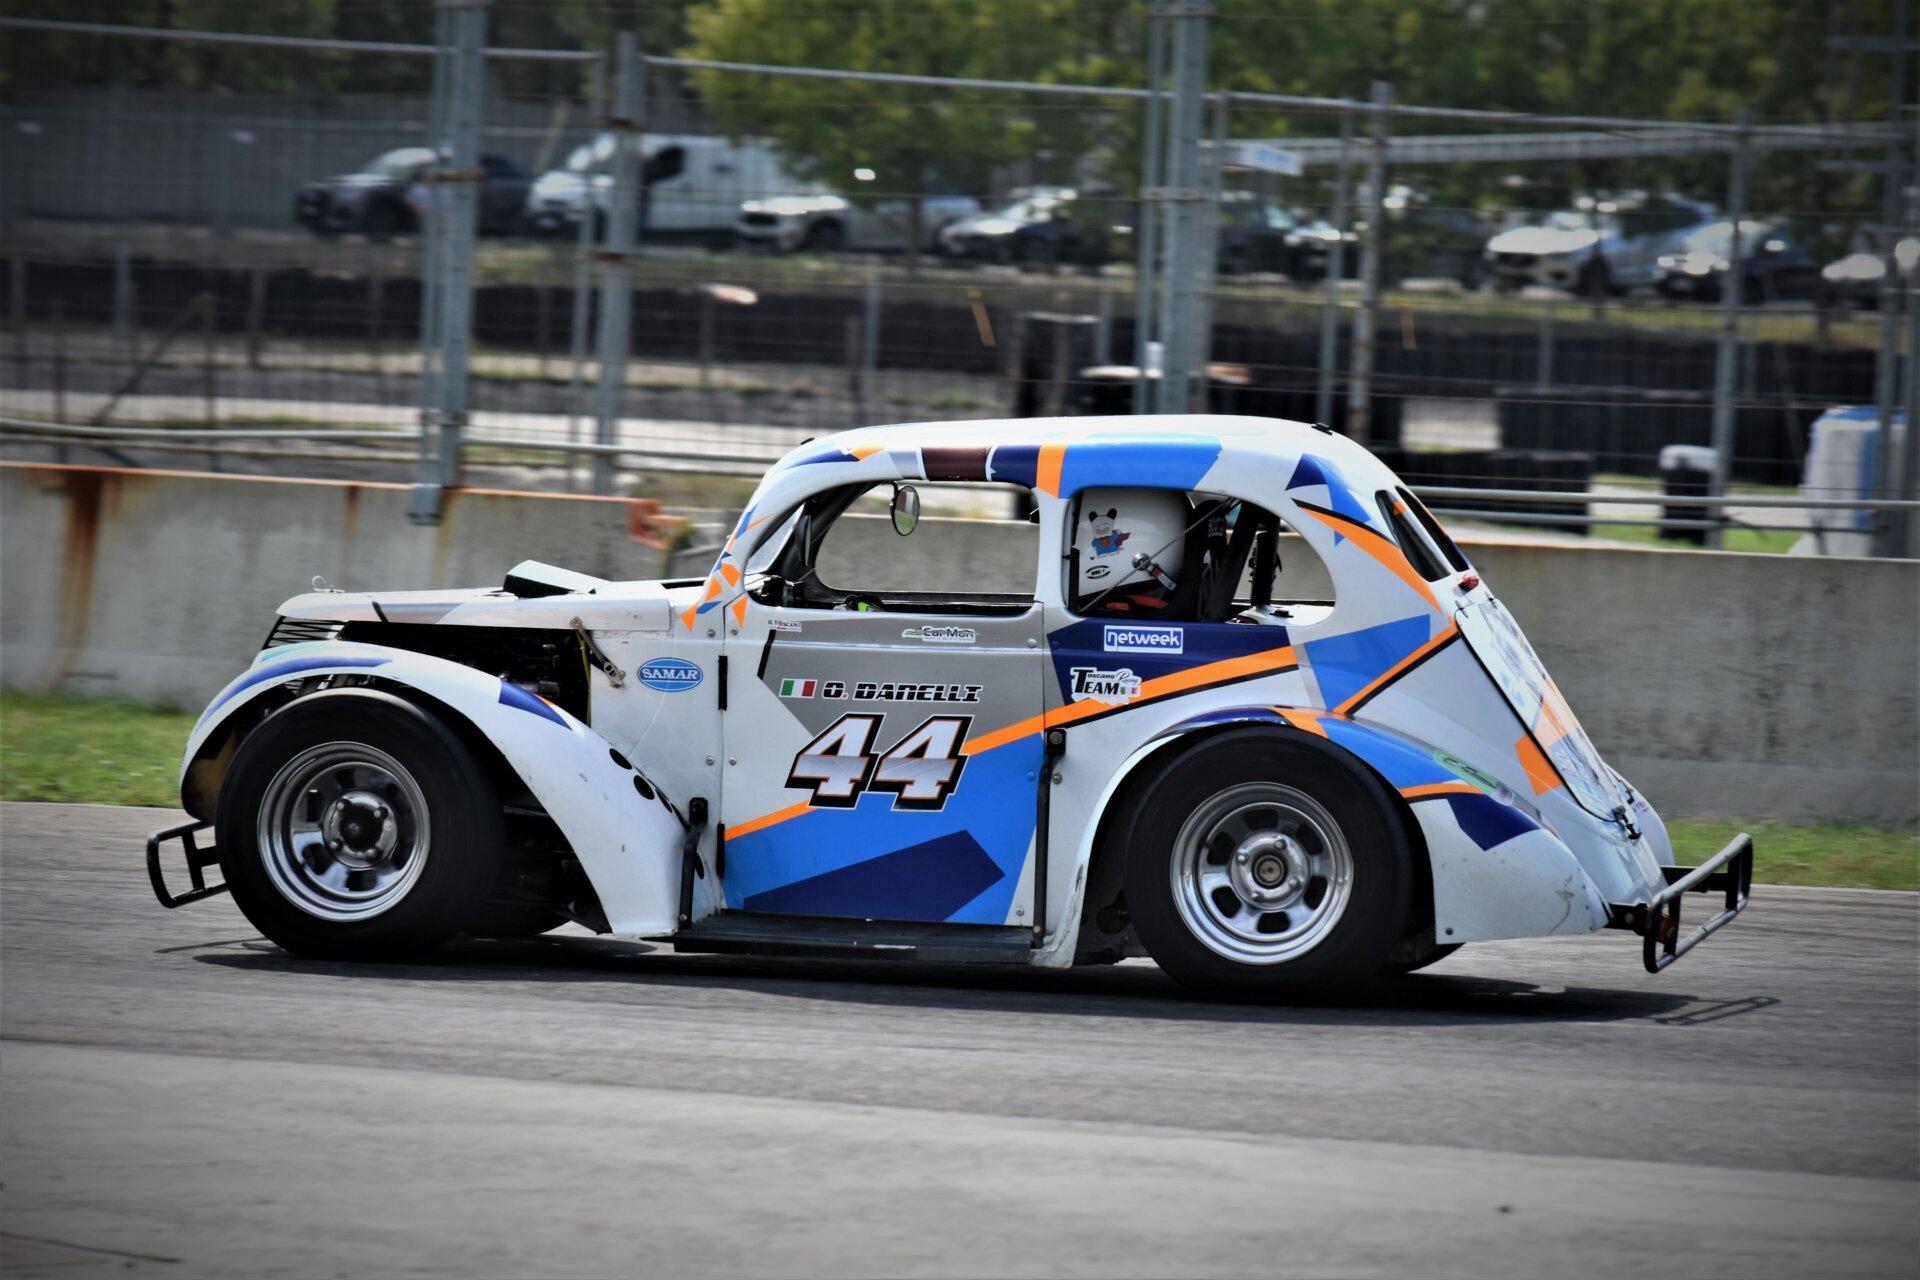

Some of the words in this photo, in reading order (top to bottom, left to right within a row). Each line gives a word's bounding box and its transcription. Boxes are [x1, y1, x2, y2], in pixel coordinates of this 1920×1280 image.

[1107, 630, 1180, 646] netweek
[642, 668, 698, 680] SAMAR
[784, 712, 975, 812] 44
